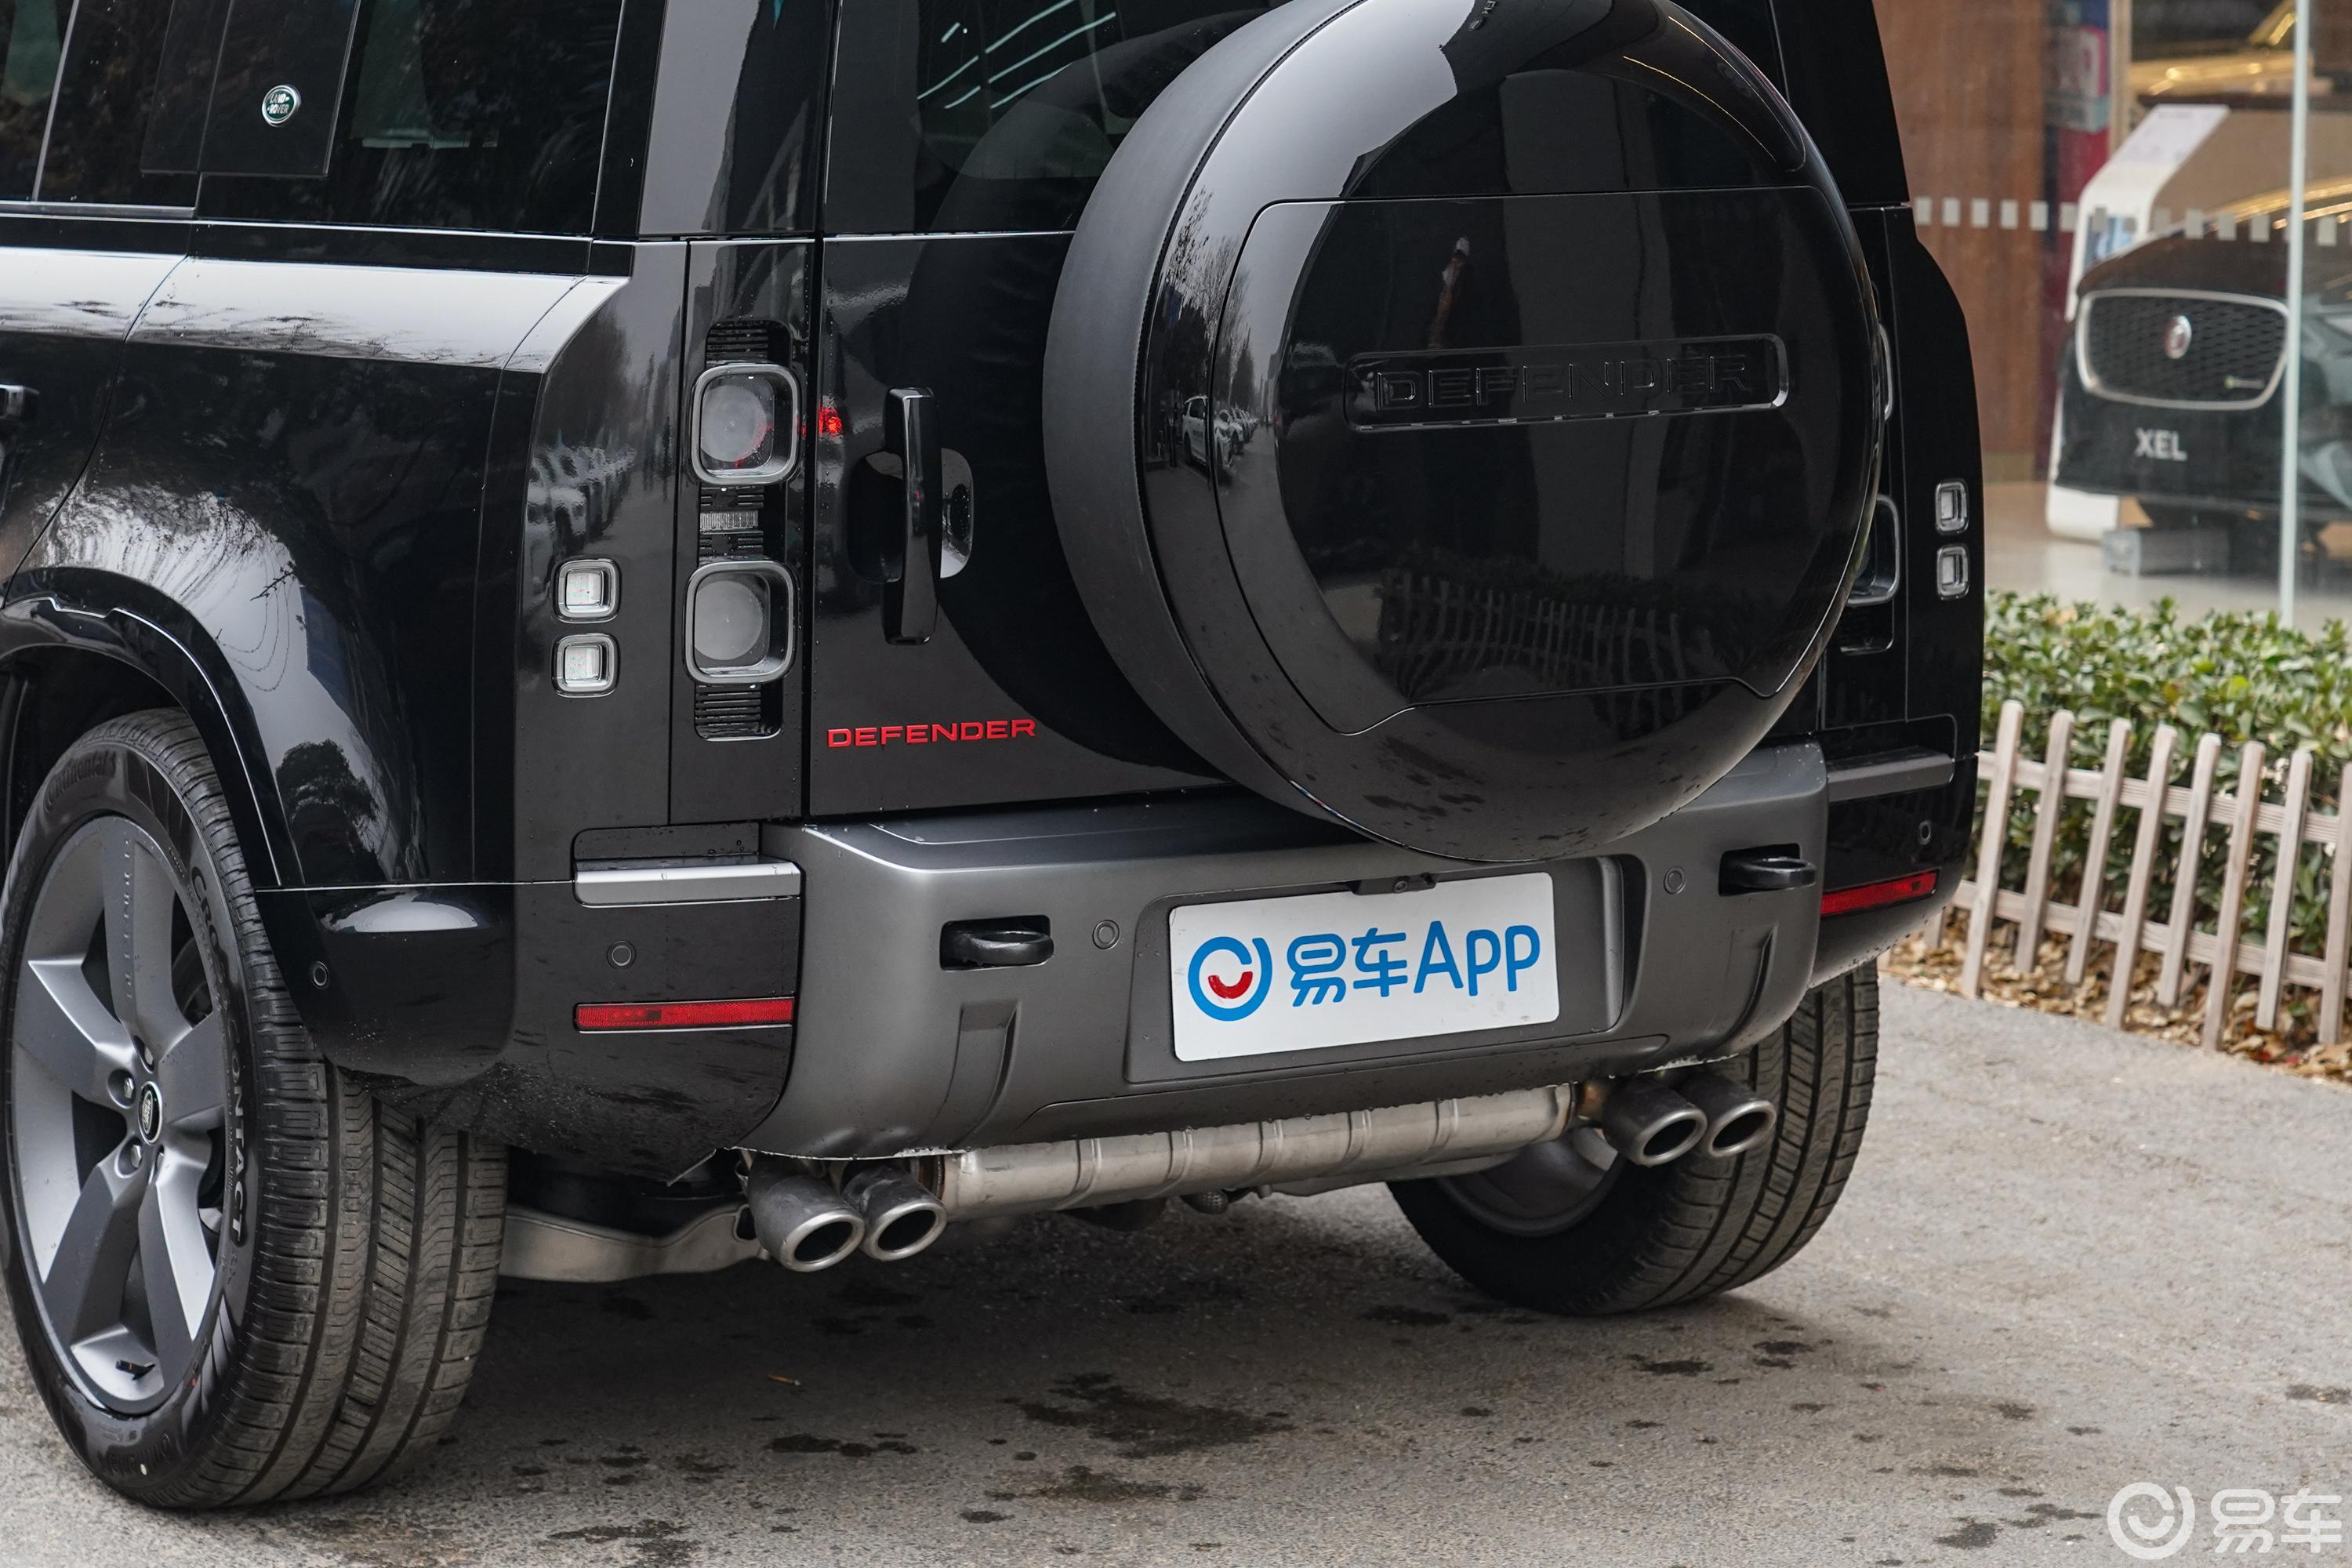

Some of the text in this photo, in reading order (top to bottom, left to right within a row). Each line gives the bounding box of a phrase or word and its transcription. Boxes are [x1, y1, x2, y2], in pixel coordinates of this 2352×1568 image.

[268, 103, 289, 114] ROVER
[269, 93, 287, 103] LAND
[1376, 354, 1748, 412] DEFENDER
[2134, 427, 2187, 462] XEL
[827, 719, 1036, 748] DEFENDER
[1287, 920, 1541, 1007] 易车App
